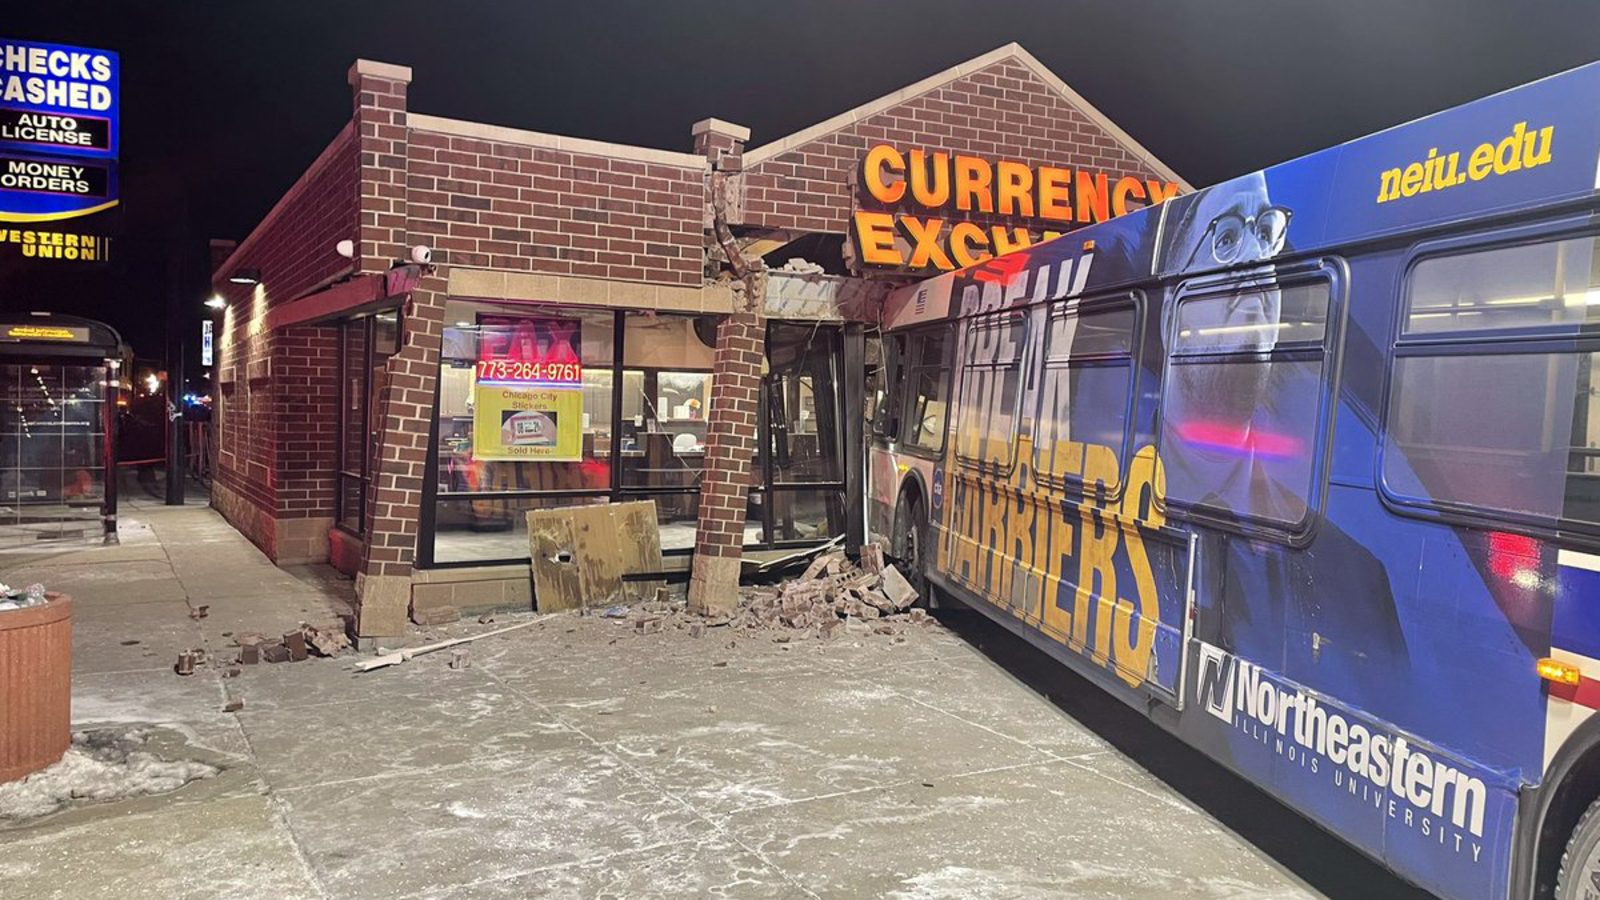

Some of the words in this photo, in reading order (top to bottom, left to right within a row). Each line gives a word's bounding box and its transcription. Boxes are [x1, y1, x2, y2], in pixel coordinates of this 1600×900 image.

[0, 45, 112, 82] HECKS
[0, 75, 112, 111] ASHED
[2, 124, 92, 145] LICENSE
[18, 113, 78, 131] AUTO
[8, 161, 84, 179] MONEY
[1376, 121, 1554, 203] neiu.edu
[1, 174, 90, 193] ORDERS
[22, 244, 95, 260] UNION
[854, 211, 1062, 273] EXCH
[481, 318, 579, 362] FAX
[948, 252, 1094, 450] BREAK
[478, 361, 581, 381] 773-264-9761
[502, 390, 538, 401] Chicago
[540, 392, 558, 402] City
[512, 401, 548, 410] Stickers
[507, 446, 528, 454] Sold
[937, 433, 1167, 689] BARRIERS
[1236, 659, 1487, 838] Northeastern
[1234, 714, 1320, 774] ILLINOIS
[1334, 771, 1482, 863] UNIVERSITY
